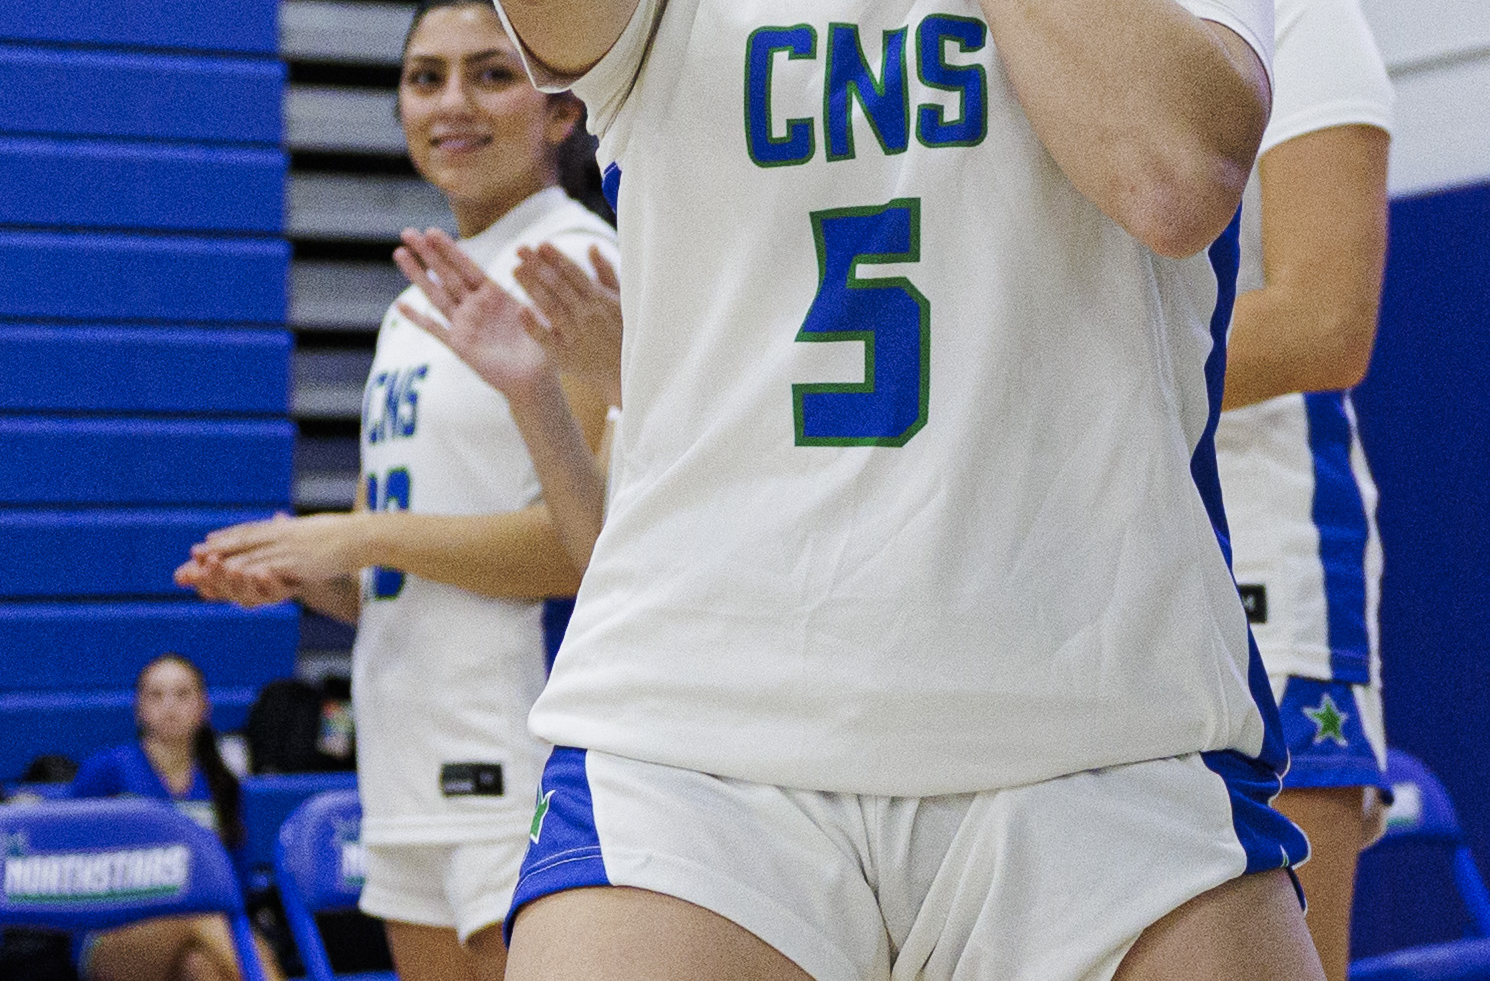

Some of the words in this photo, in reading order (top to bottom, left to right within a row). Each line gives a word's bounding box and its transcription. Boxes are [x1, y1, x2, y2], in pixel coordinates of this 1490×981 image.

[744, 13, 988, 169] CNS
[791, 196, 932, 448] 5
[360, 363, 429, 446] CNS
